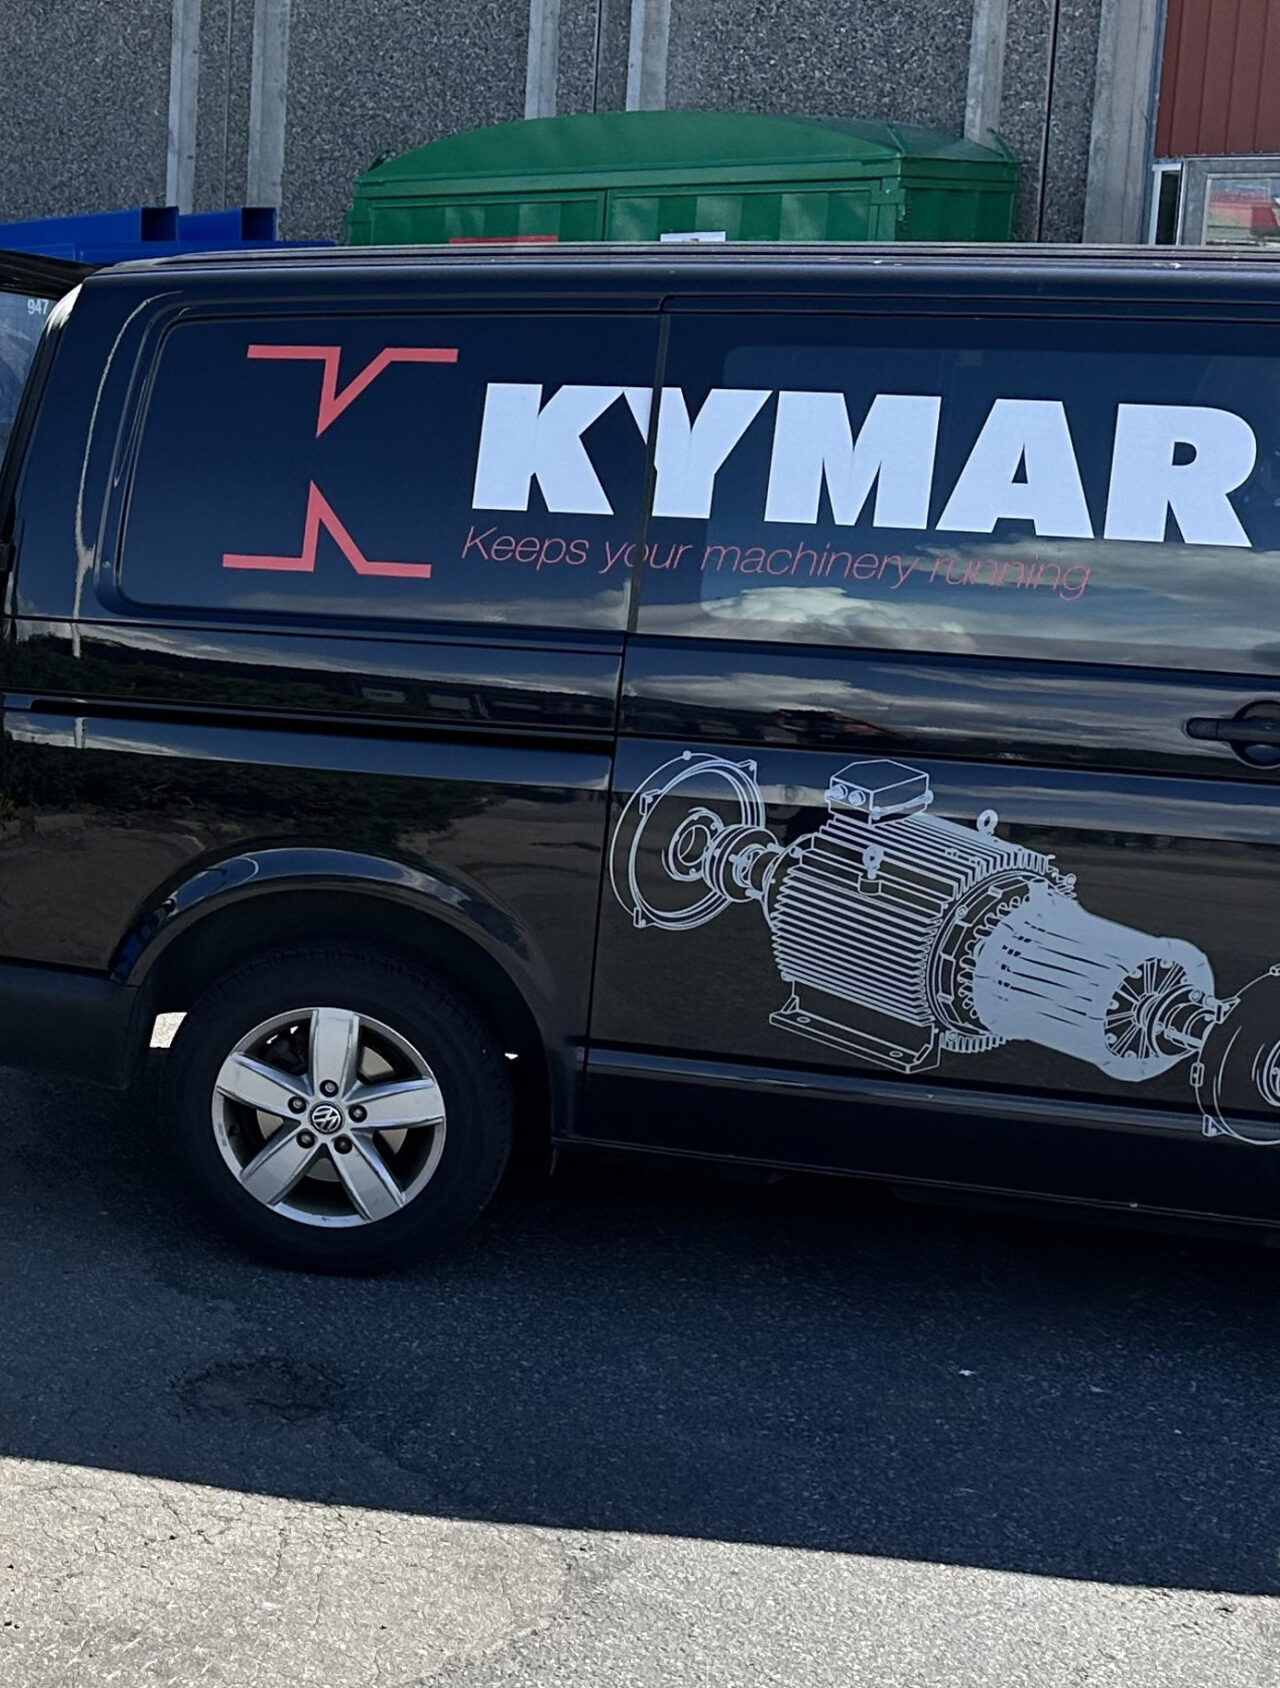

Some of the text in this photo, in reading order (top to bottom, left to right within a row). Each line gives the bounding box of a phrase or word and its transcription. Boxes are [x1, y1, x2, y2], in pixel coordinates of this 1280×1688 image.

[471, 382, 1258, 548] KYMAR
[461, 525, 1092, 600] Keeps your machinery running
